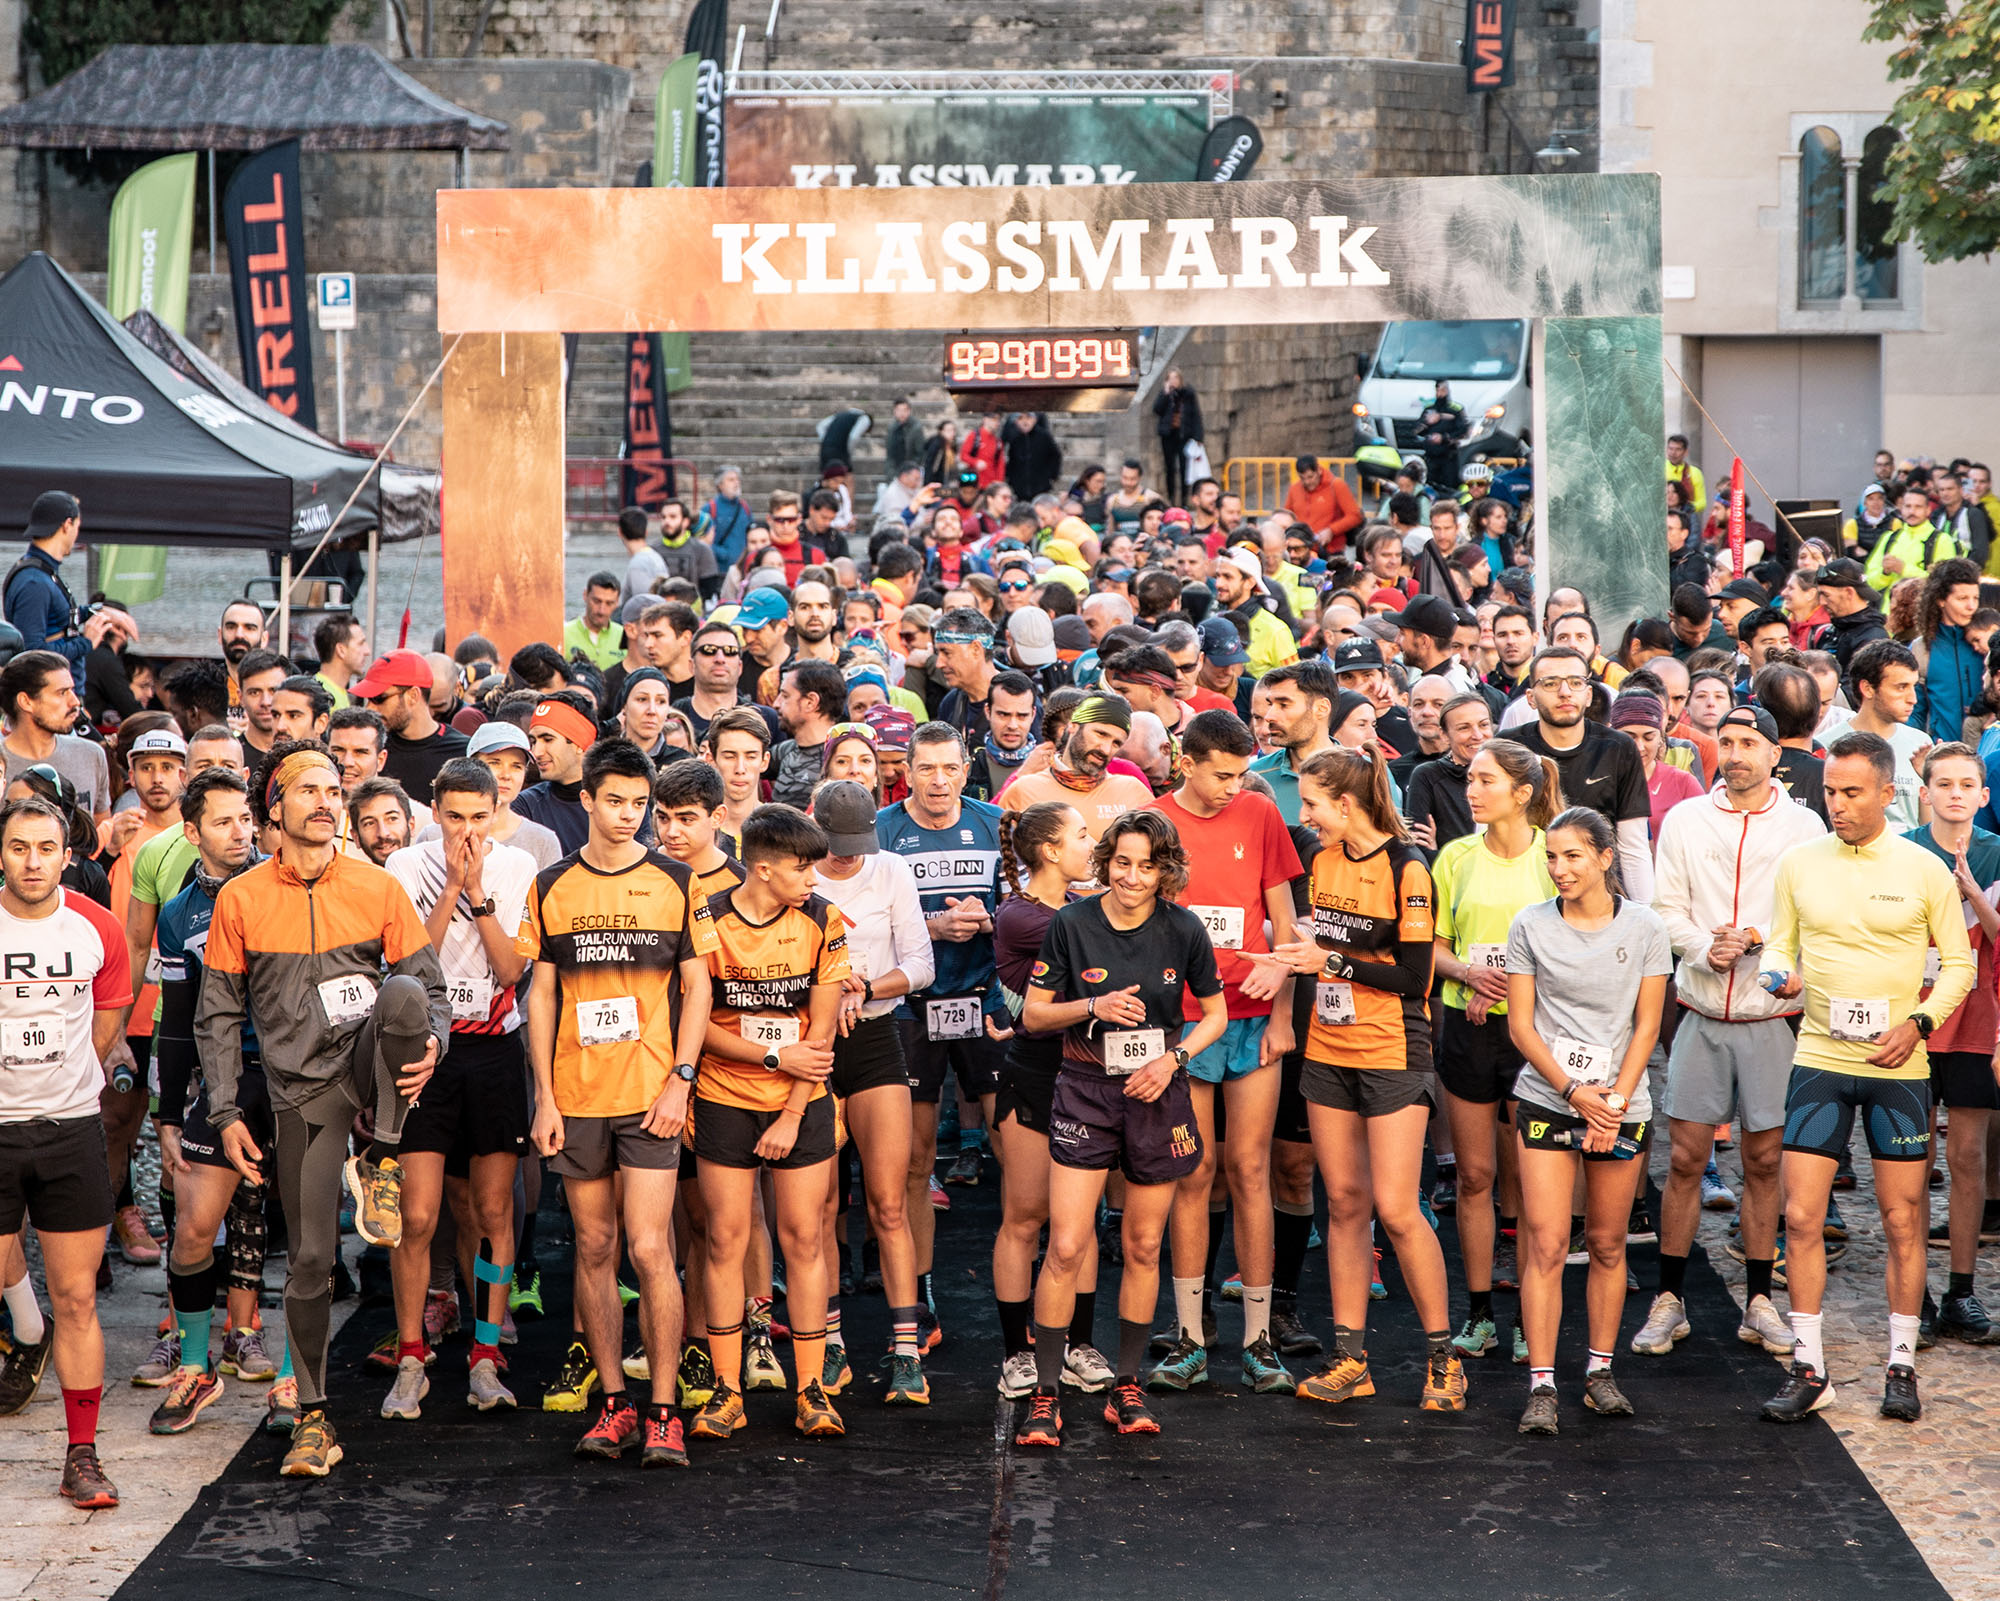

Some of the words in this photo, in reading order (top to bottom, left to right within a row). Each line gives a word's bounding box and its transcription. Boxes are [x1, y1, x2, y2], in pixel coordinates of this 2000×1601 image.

[712, 215, 1390, 295] KLASSMARK
[141, 228, 158, 310] omoot
[326, 279, 347, 305] P
[1316, 892, 1359, 912] ESCOLETA
[572, 915, 638, 931] ESCOLETA
[1204, 916, 1227, 931] 730
[1486, 953, 1506, 969] 815
[725, 963, 793, 979] ESCOLETA
[0, 984, 88, 999] EAM
[339, 985, 363, 1005] 781
[450, 987, 474, 1004] 786
[1325, 993, 1341, 1010] 846
[595, 1009, 620, 1027] 726
[943, 1009, 966, 1025] 729
[1848, 1009, 1871, 1025] 791
[23, 1030, 46, 1047] 910
[757, 1026, 782, 1041] 788
[1123, 1042, 1148, 1058] 869
[1567, 1051, 1594, 1070] 887
[1171, 1124, 1190, 1142] AVE
[1170, 1137, 1198, 1159] FENIX
